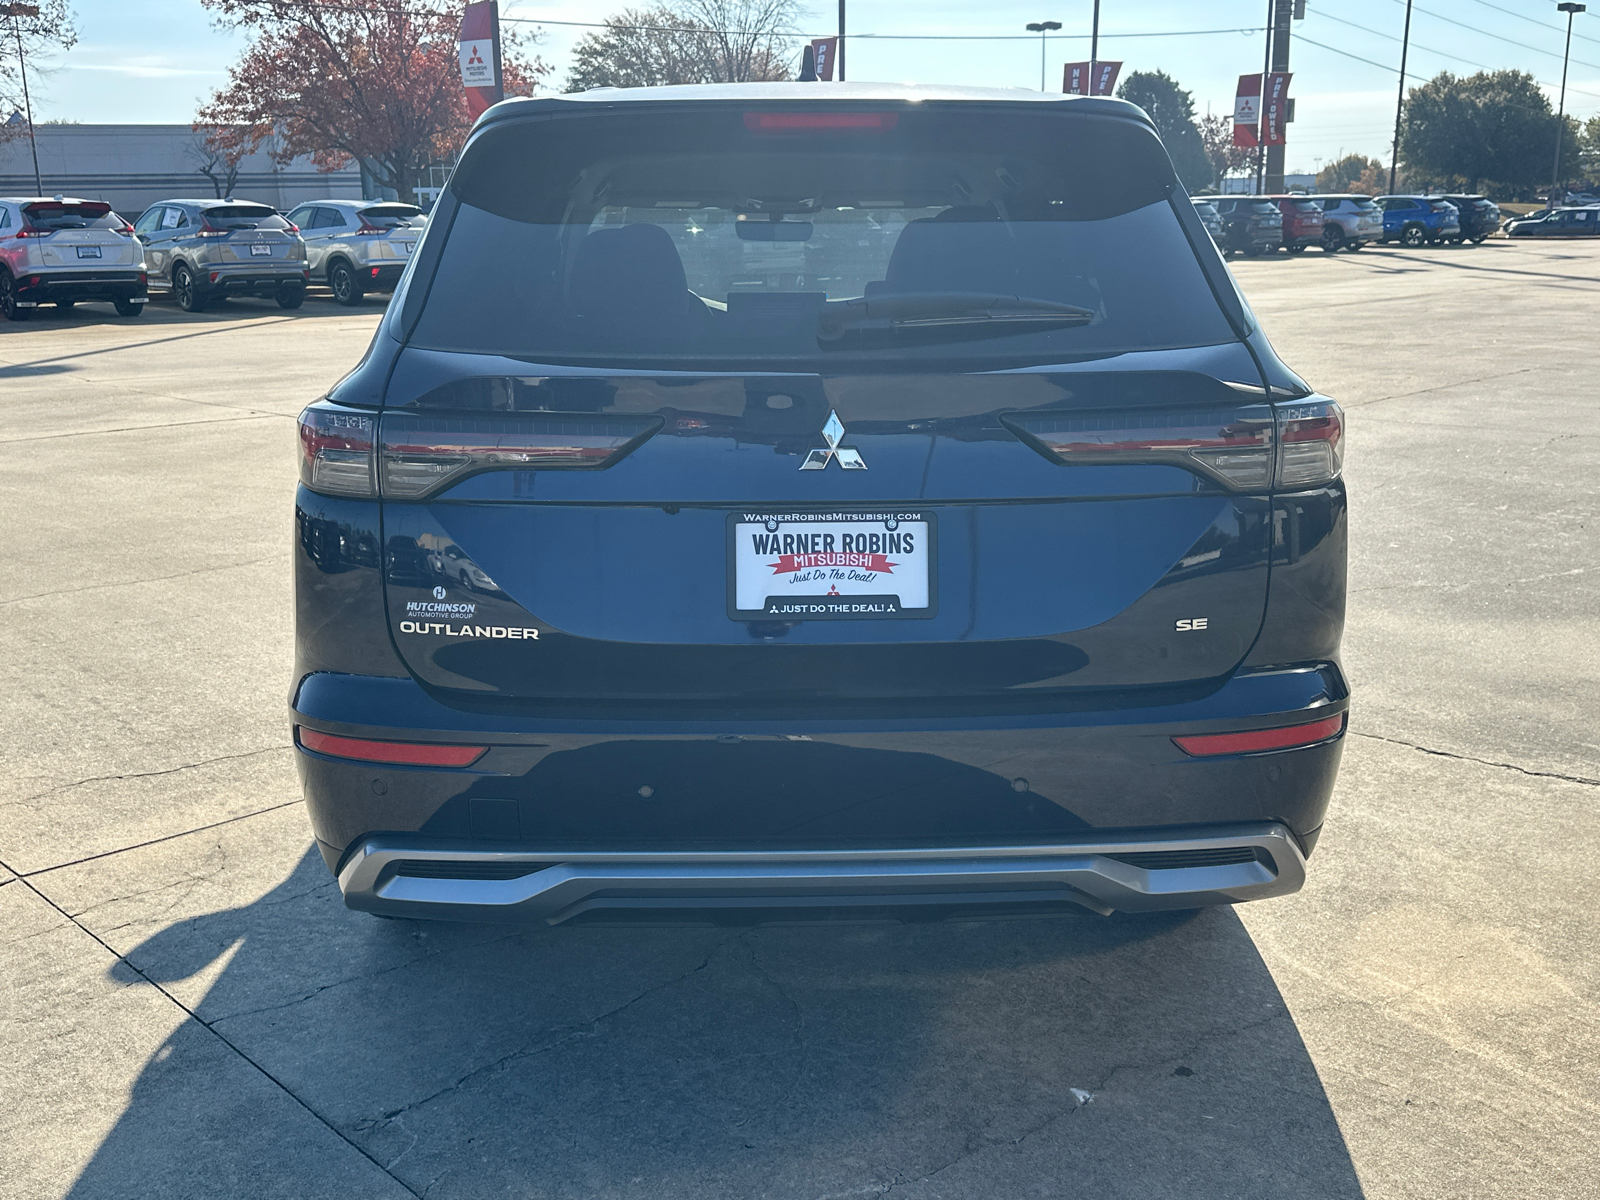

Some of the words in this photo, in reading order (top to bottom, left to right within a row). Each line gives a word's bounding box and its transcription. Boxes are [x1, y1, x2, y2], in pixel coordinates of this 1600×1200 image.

[1268, 77, 1283, 140] PRE-OWNED
[752, 533, 835, 555] WARNER
[842, 533, 914, 554] ROBINS
[794, 554, 872, 567] MITSUBISHI
[790, 572, 811, 584] Just
[813, 569, 826, 580] Do
[830, 569, 845, 579] The
[848, 570, 877, 583] Deal!
[406, 602, 476, 613] HUTCHINSON
[780, 605, 808, 613] JUST
[810, 605, 826, 613] DO
[852, 604, 884, 612] DEAL!
[400, 621, 539, 640] OUTLANDER
[1176, 618, 1208, 631] SE
